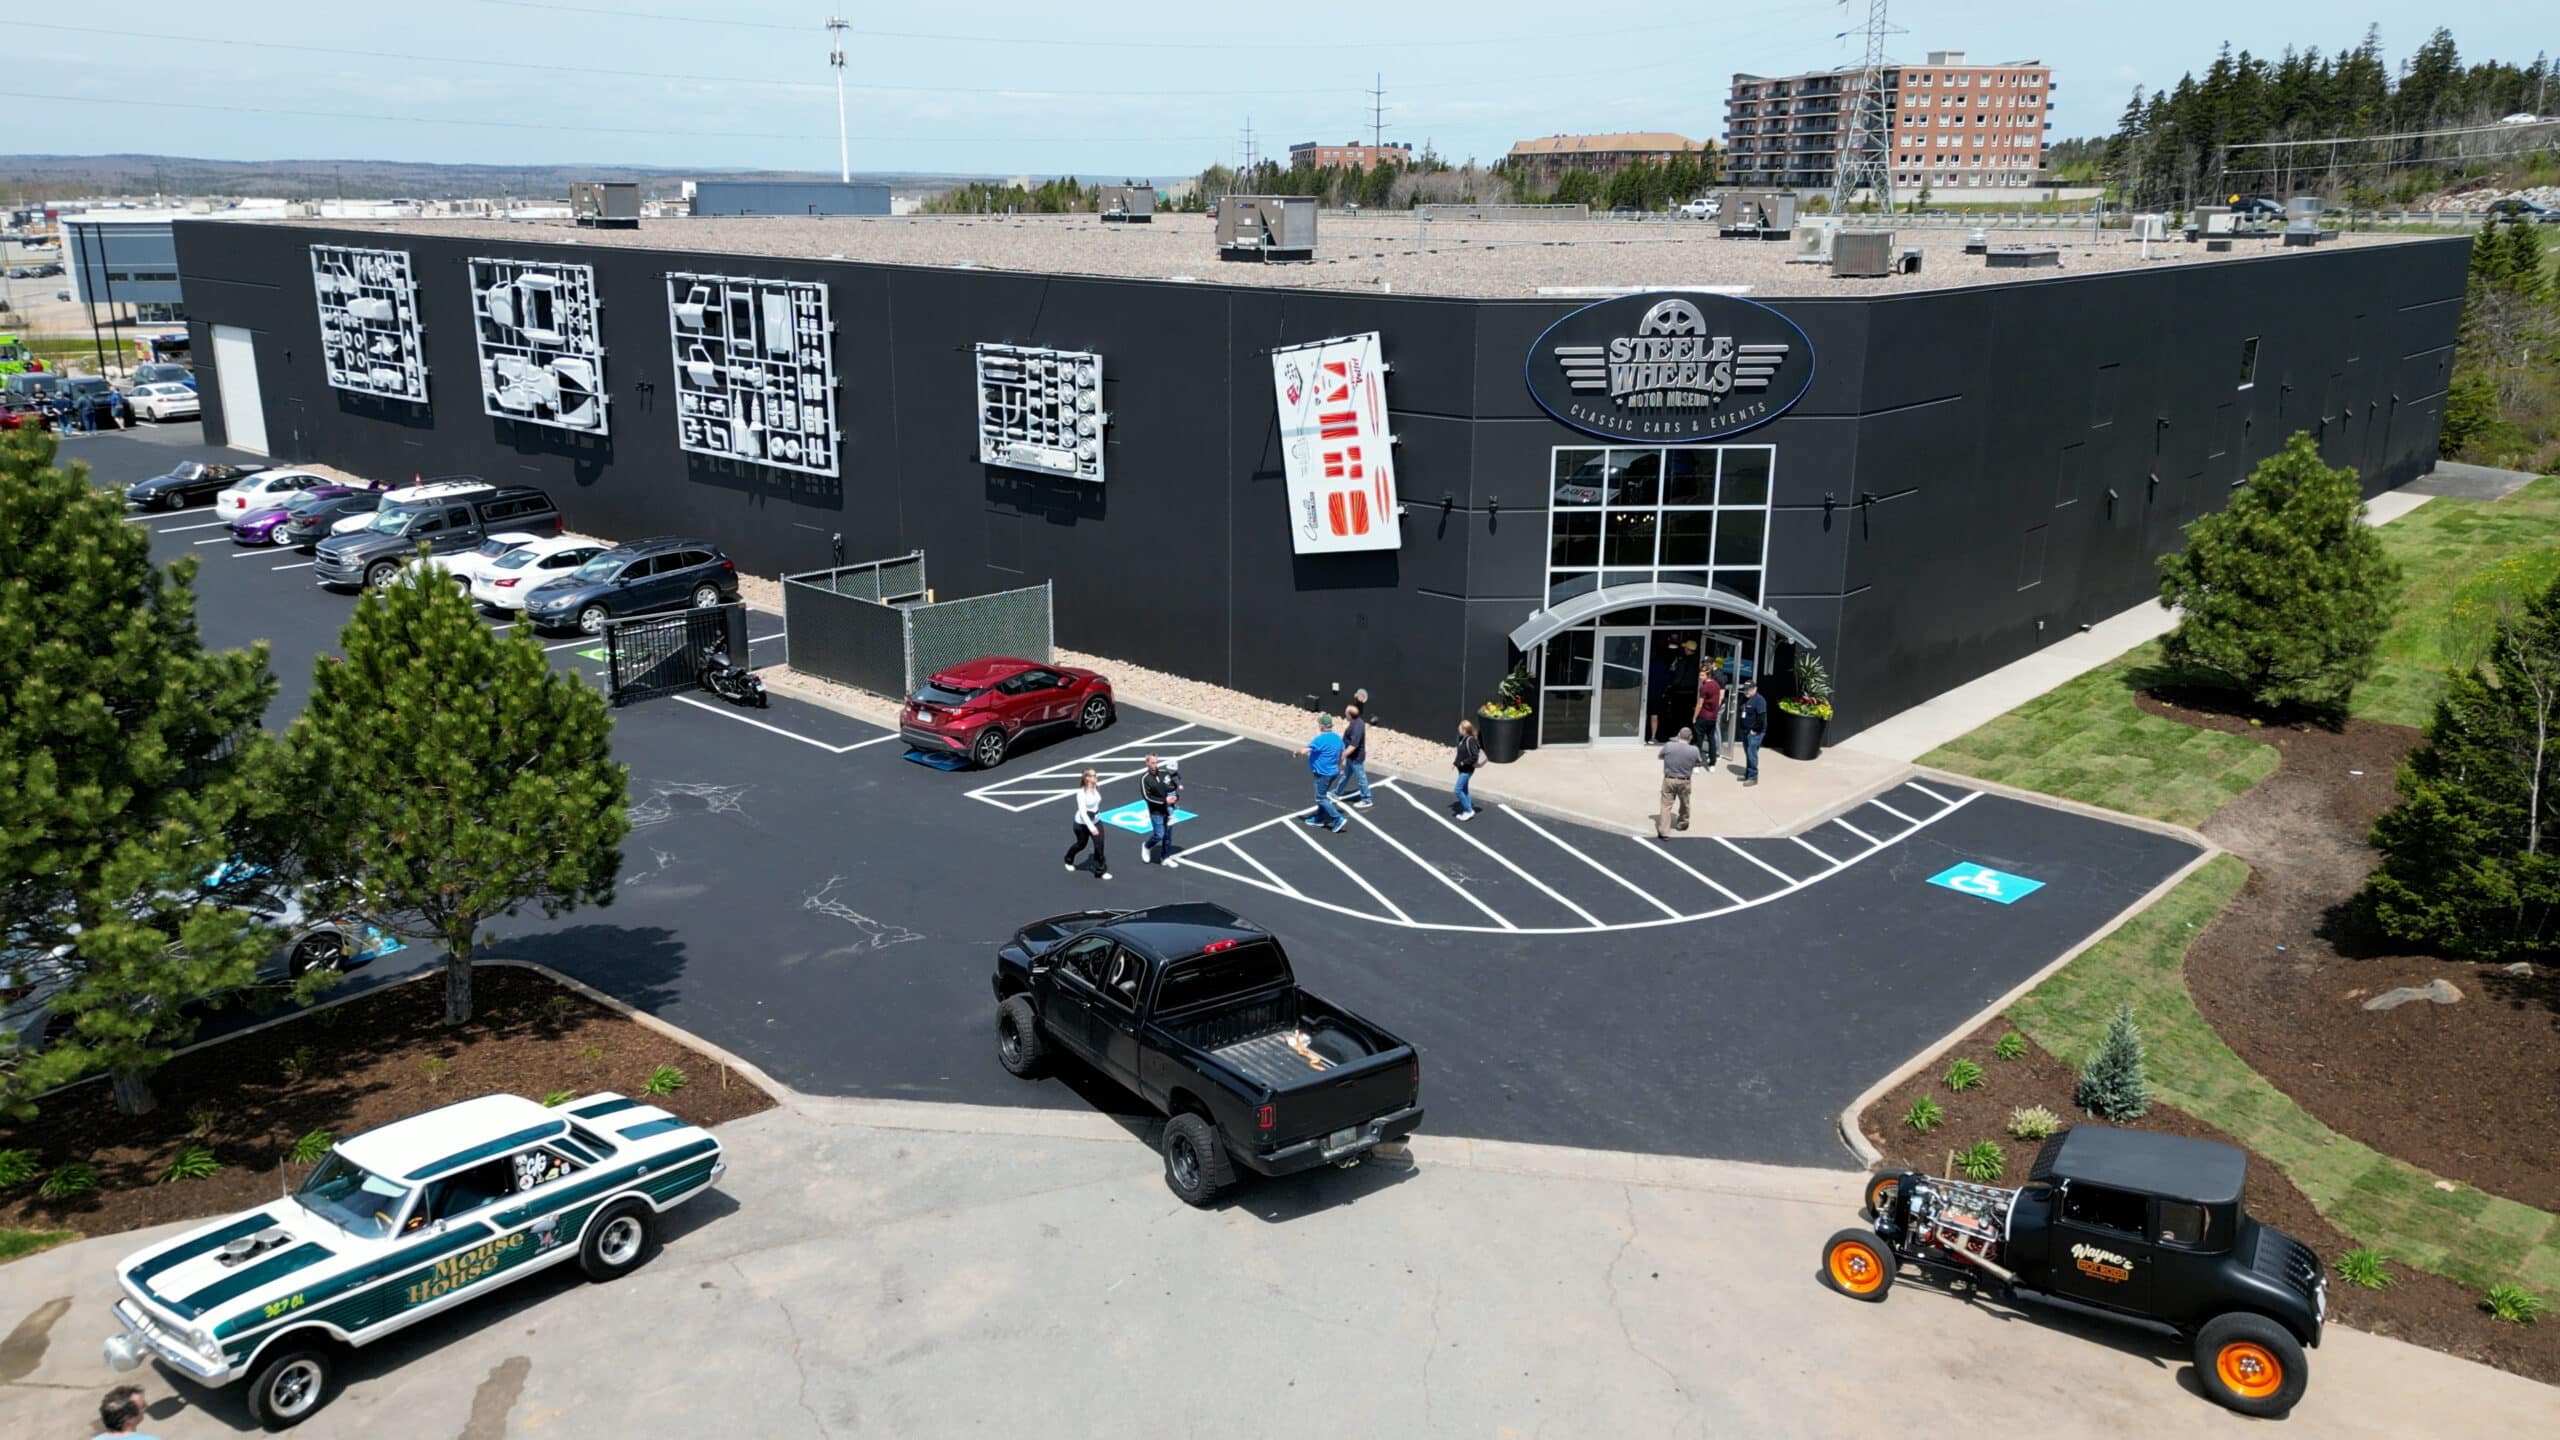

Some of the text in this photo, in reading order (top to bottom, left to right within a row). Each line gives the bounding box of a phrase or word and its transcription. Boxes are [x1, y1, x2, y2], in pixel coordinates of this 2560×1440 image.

[1610, 337, 1734, 363] STEELE
[1609, 362, 1732, 396] WHEELS
[1628, 392, 1709, 407] MOTOR MUSEUM
[1570, 402, 1767, 433] CLASSIC CARS & EVENTS
[433, 1233, 525, 1282] Mouse
[2071, 1243, 2134, 1270] Wayne's
[408, 1255, 499, 1303] House
